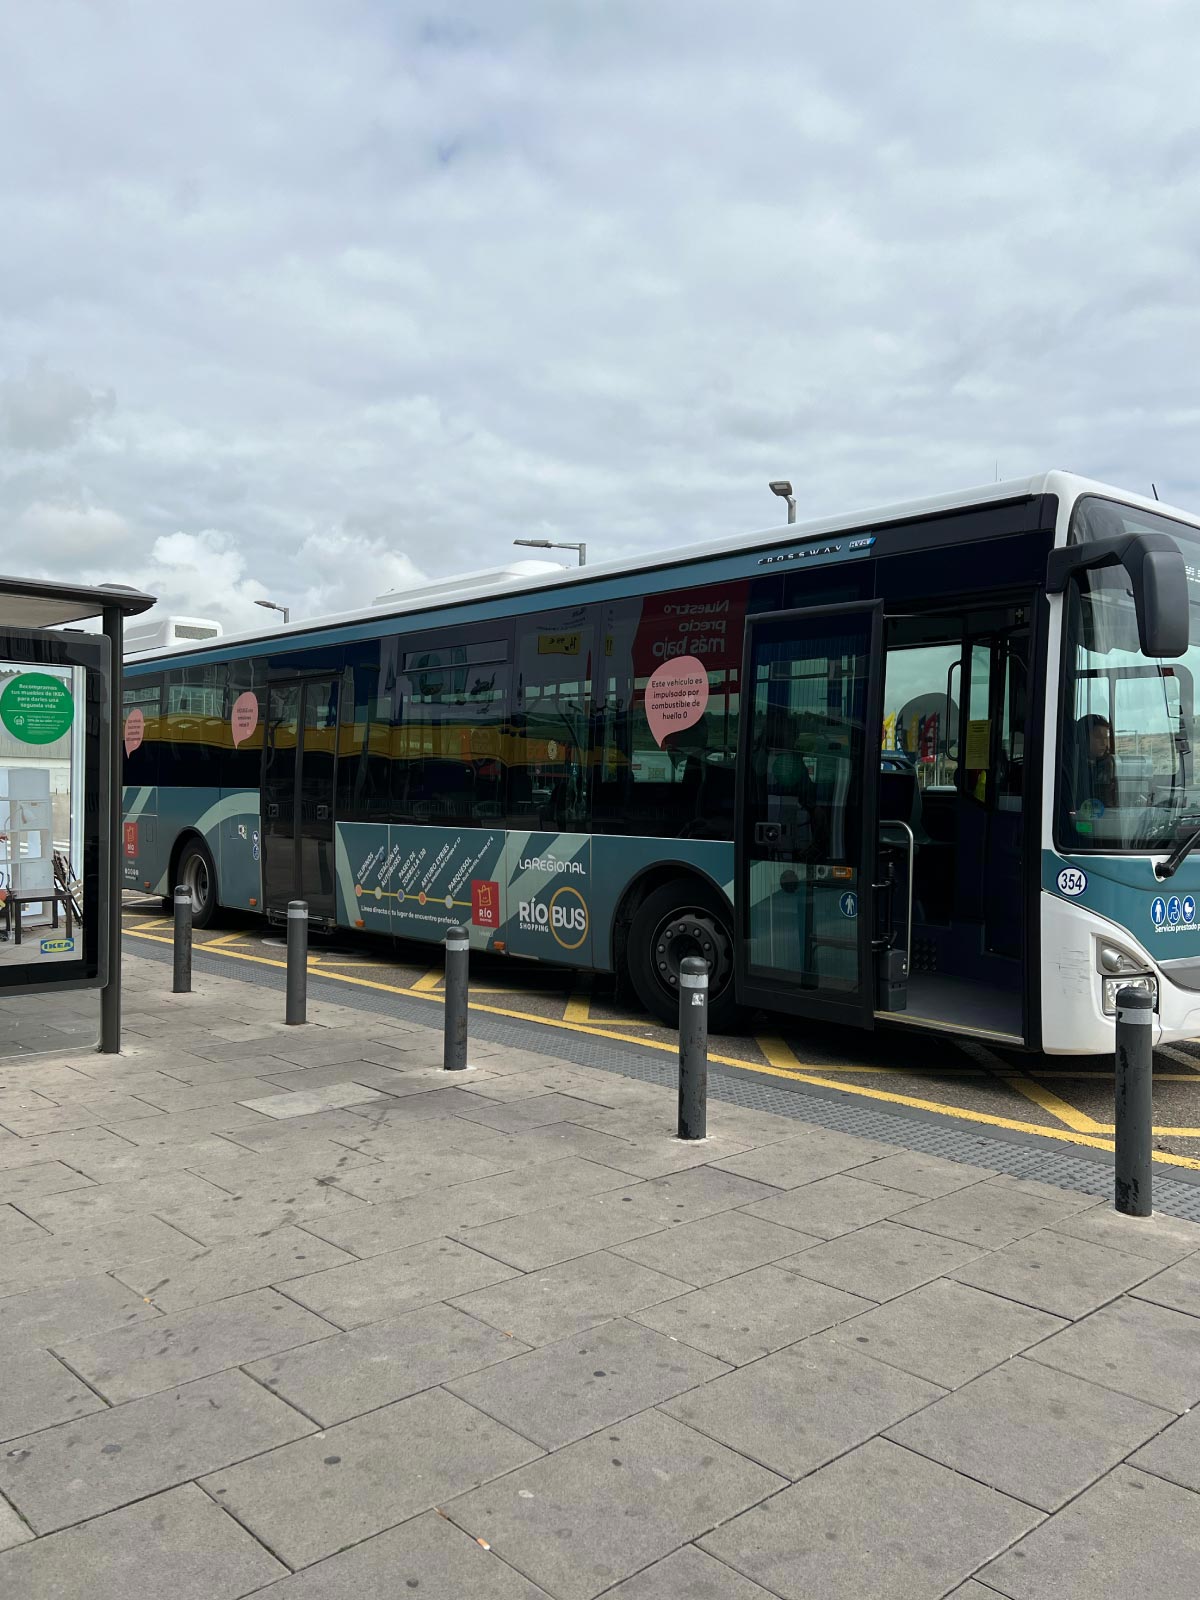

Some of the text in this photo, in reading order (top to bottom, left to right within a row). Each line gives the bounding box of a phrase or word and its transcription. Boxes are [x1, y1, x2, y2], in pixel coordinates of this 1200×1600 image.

[651, 680, 666, 688] Este
[653, 689, 700, 700] impulsado por
[651, 699, 701, 710] combustible de
[662, 711, 682, 720] huella
[448, 856, 473, 892] PARQUESOL
[1060, 872, 1083, 891] 354
[414, 913, 437, 922] encuentro
[437, 915, 460, 925] preferido
[519, 922, 549, 933] SHOPPING
[1154, 923, 1176, 933] Servicio
[1175, 922, 1198, 934] prestado
[43, 942, 71, 950] IKEA
